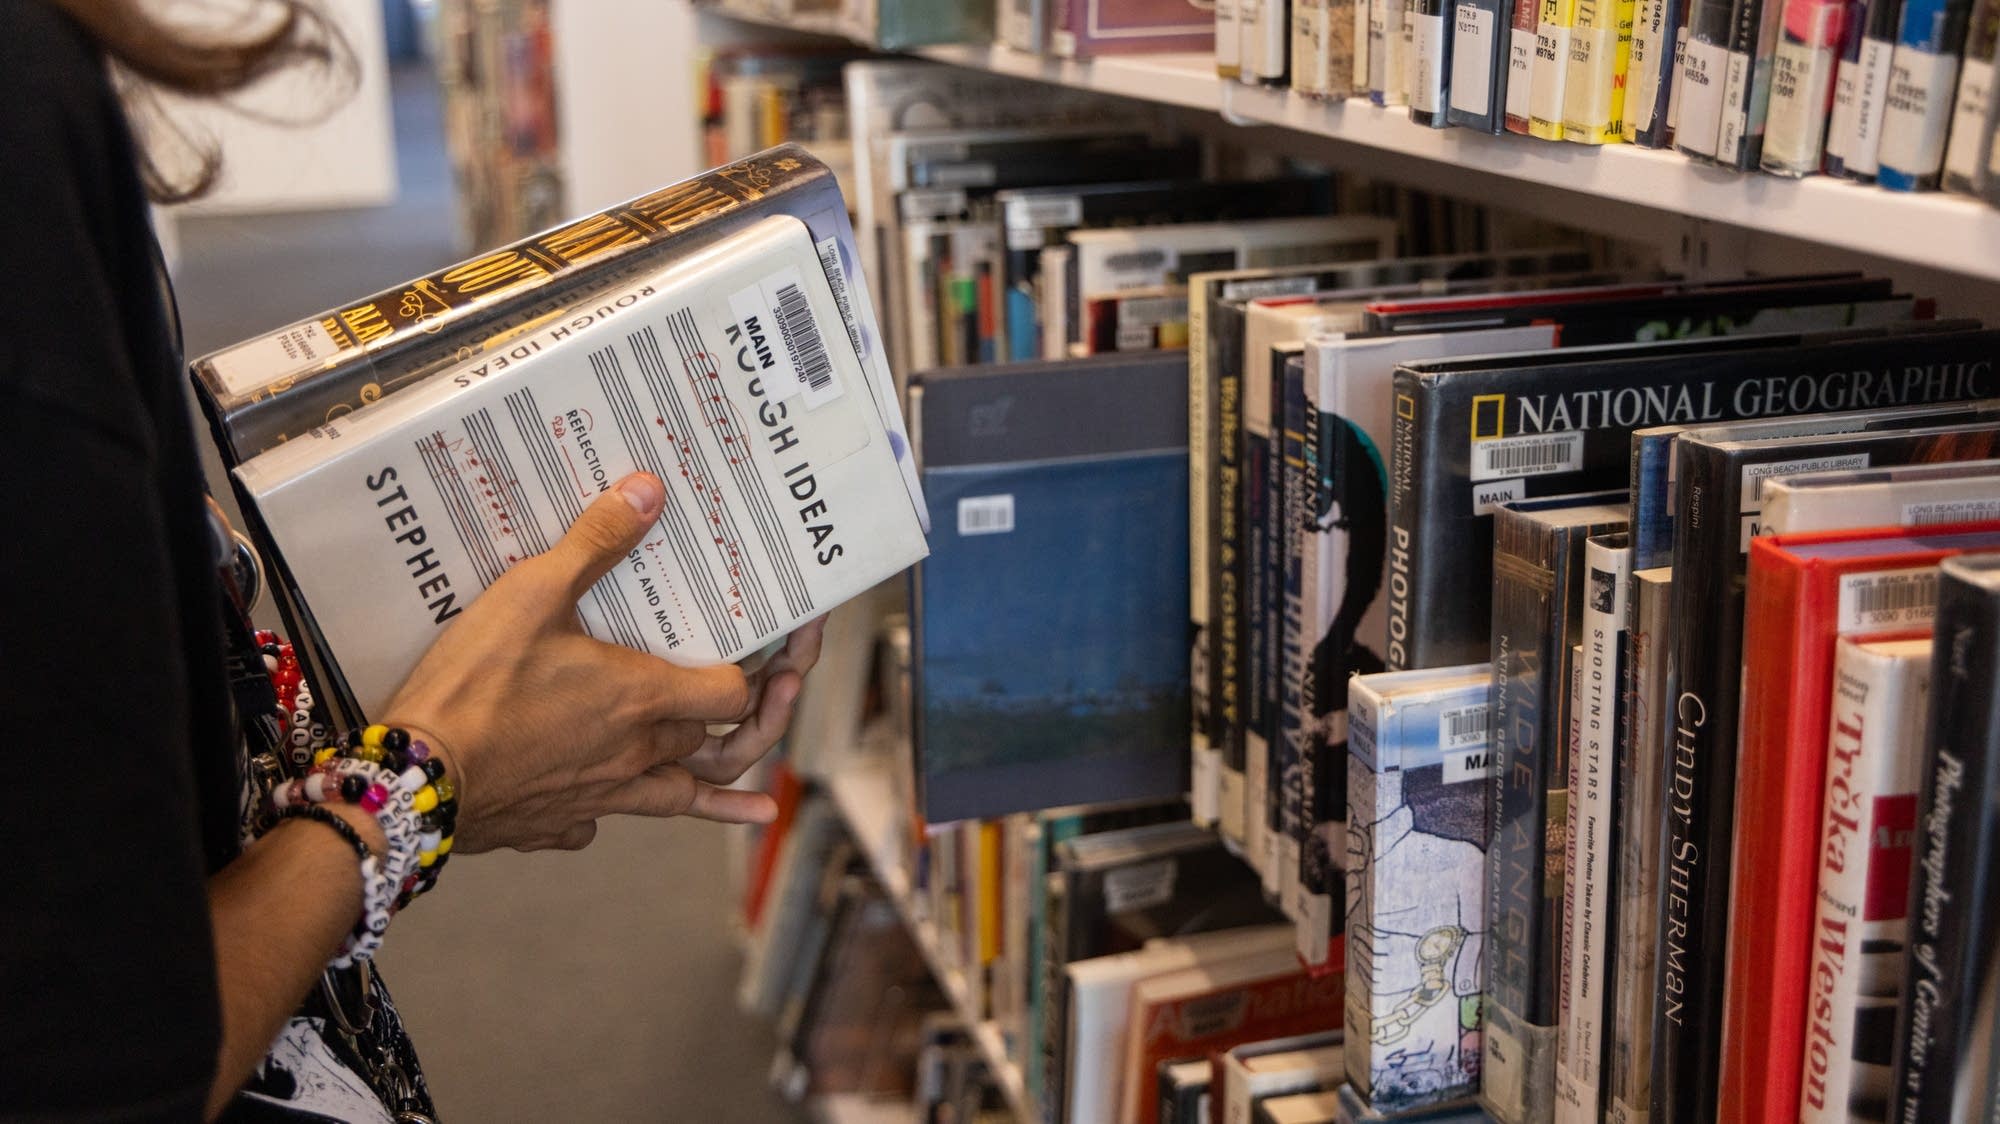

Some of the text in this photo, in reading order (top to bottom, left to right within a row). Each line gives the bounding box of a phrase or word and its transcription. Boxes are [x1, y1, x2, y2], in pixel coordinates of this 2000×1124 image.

[1537, 34, 1557, 49] 778.9
[454, 285, 657, 388] ROUGH IDEAS
[828, 244, 862, 354] LONG BEACH PUBLIC LIBRARY
[744, 315, 776, 370] MAIN
[773, 306, 807, 384] 33090030197240
[1517, 360, 1993, 435] NATIONAL GEOGRAPHIC
[566, 408, 610, 492] REFLECTION
[1393, 418, 1404, 509] GEOGRAPHIC
[1402, 421, 1414, 491] NATIONAL
[1748, 457, 1864, 476] LONG BEACH PUBLIC LIBRARY
[784, 461, 844, 567] IDEAS
[1480, 490, 1513, 505] MAIN
[1691, 485, 1702, 529] Respini
[1908, 502, 1996, 514] LONG BEACH PUBLIC
[366, 466, 462, 625] STEPHEN
[1847, 579, 1873, 590] LONG
[1877, 575, 1909, 586] BEACH
[639, 575, 662, 608] AND
[653, 609, 681, 650] MORE
[1498, 635, 1509, 720] NATIONAL
[1589, 628, 1604, 731] SHOOTING
[1569, 717, 1581, 759] FINE
[1586, 740, 1600, 800] STARS
[1567, 762, 1579, 793] ART
[1505, 651, 1538, 1021] WIDE ANGLE
[1565, 794, 1578, 881] FLOWER
[1584, 815, 1596, 850] Favorite
[1920, 750, 1964, 937] Photographers
[1585, 878, 1594, 907] Taken
[1560, 883, 1576, 1016] PHOTOGRAPHY
[1582, 919, 1592, 951] Classic
[1580, 953, 1591, 999] Celebrities
[1805, 916, 1848, 1112] Weston
[1908, 978, 1940, 1068] Genius
